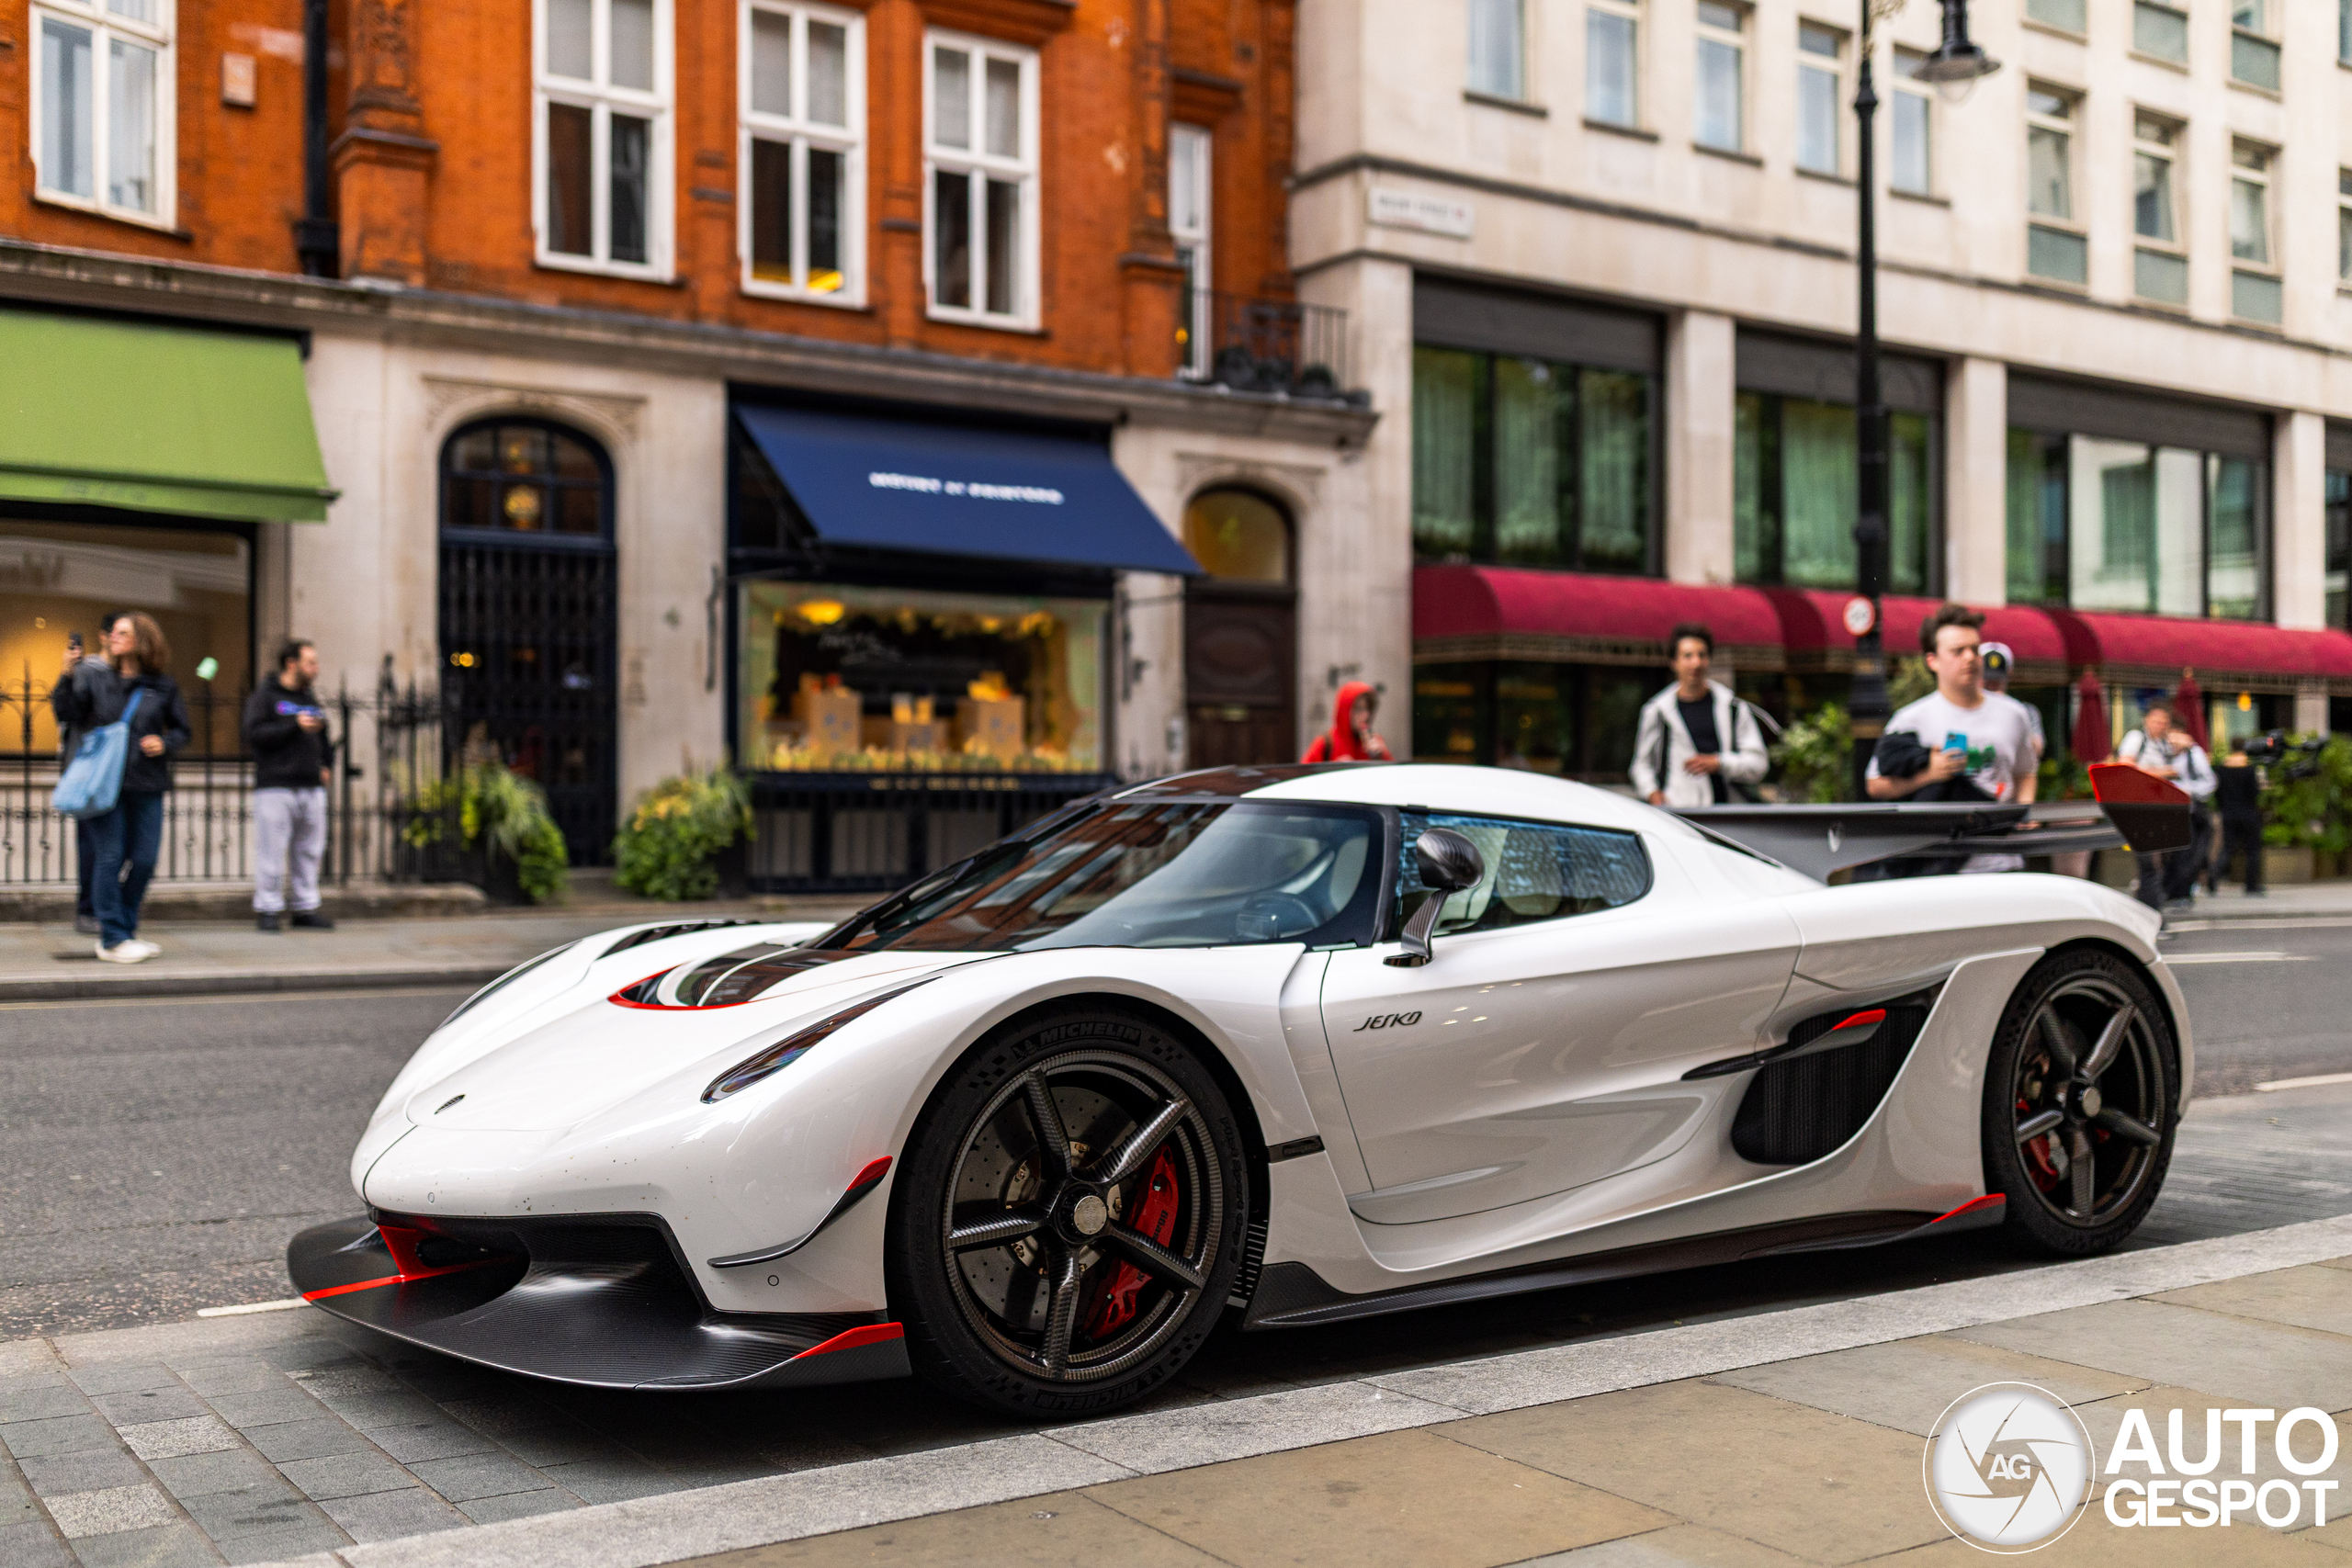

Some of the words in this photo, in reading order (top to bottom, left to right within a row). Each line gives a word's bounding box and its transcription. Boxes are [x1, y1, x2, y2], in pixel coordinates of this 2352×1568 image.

[1039, 1021, 1141, 1047] MICHELIN
[1352, 1010, 1423, 1032] JESKO
[1231, 1159, 1245, 1211] Sport
[1035, 1379, 1140, 1411] MICHELIN
